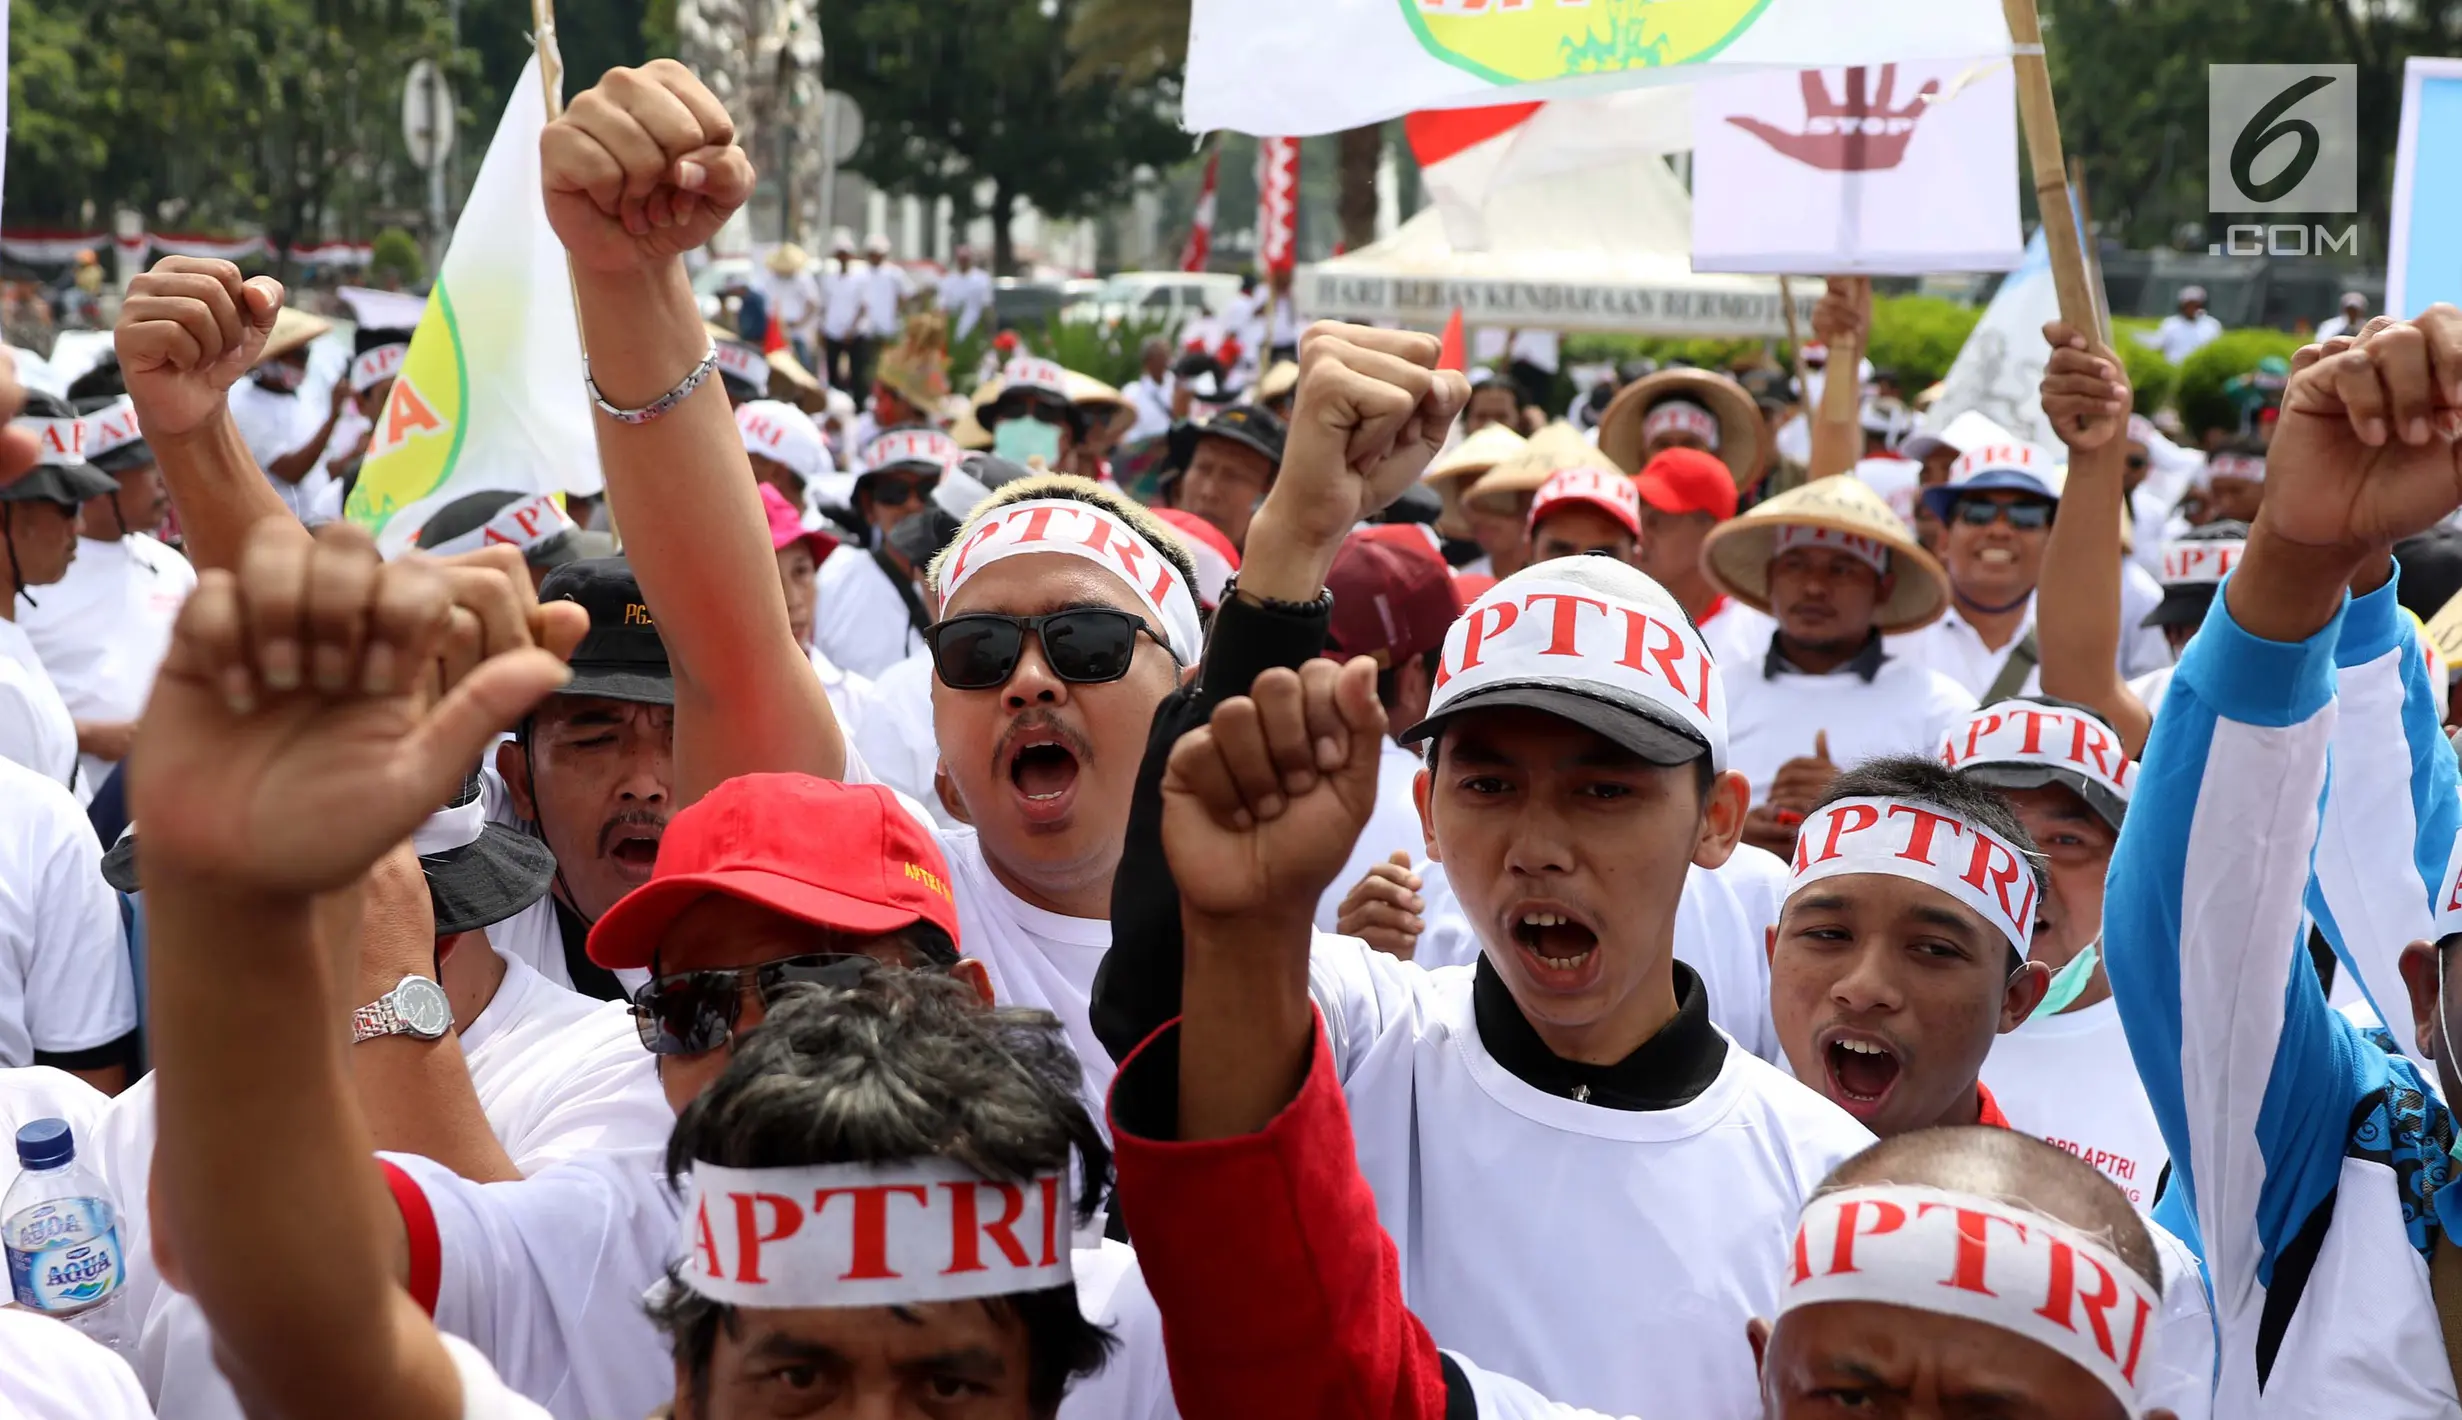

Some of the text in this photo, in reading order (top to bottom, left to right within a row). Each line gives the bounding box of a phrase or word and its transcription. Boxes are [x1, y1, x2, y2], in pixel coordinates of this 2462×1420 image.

[1807, 116, 1914, 136] STOP
[1316, 275, 1386, 308] HARI
[1939, 709, 2129, 789] APTRI
[1791, 804, 2036, 943] APTRI
[2082, 1146, 2137, 1181] APTRI
[694, 1176, 1059, 1285] APTRI
[46, 1250, 112, 1288] AQUA
